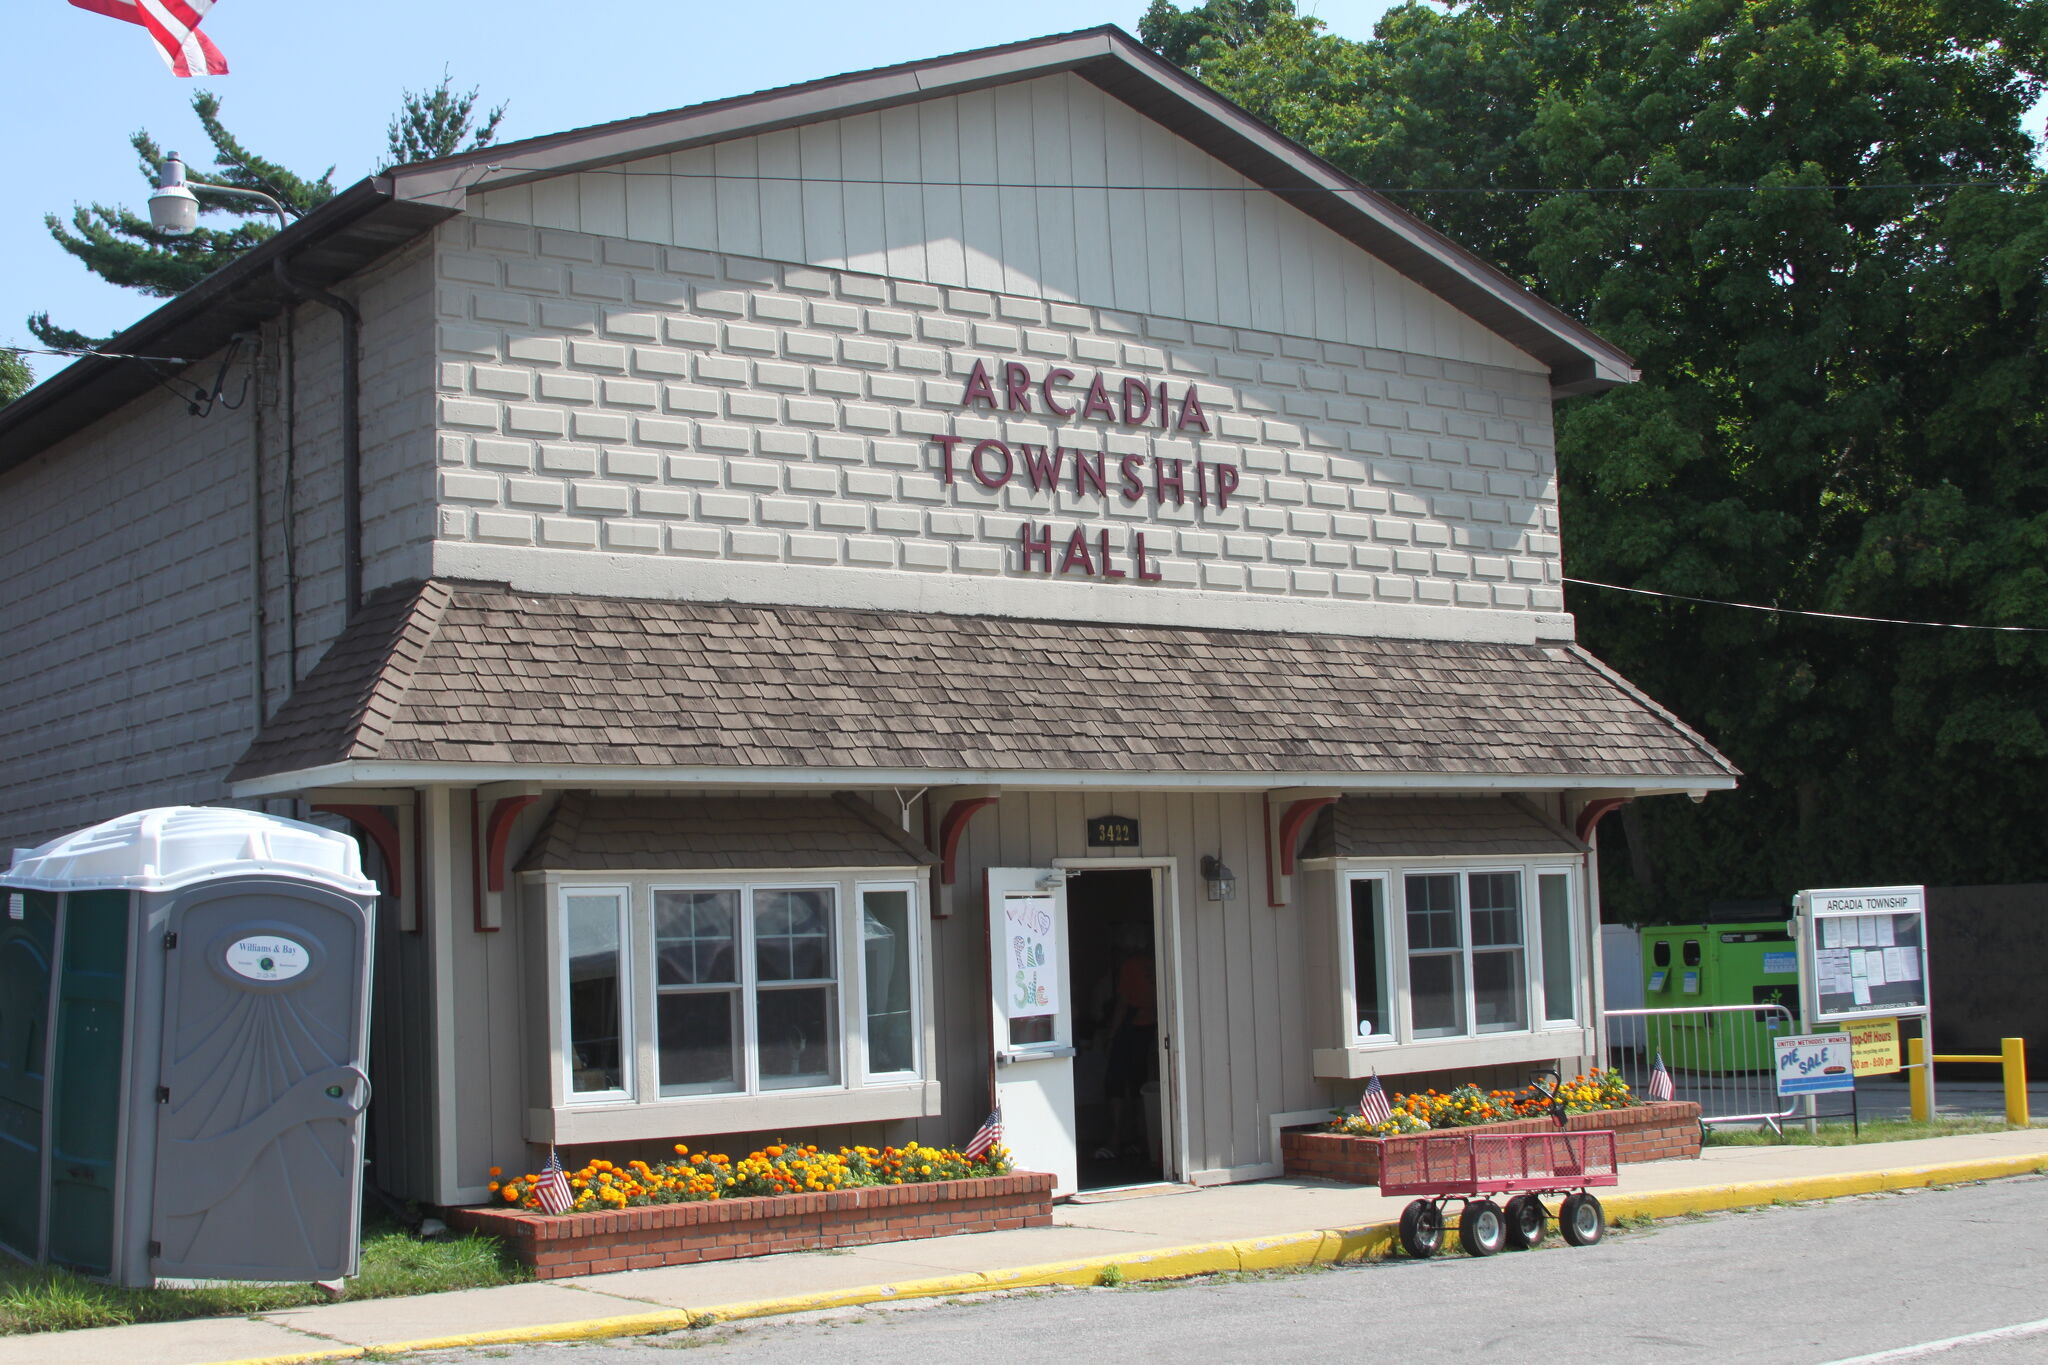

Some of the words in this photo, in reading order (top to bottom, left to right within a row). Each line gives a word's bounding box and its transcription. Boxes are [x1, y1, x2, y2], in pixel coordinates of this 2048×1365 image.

[963, 358, 1210, 433] ARCADIA
[932, 434, 1239, 509] TOWNSHIP
[1022, 522, 1162, 581] HALL
[1098, 824, 1129, 841] 3422
[1827, 899, 1863, 910] ARCADIA
[1866, 897, 1908, 909] TOWNSHIP
[239, 942, 272, 953] Williams
[273, 944, 280, 953] &
[282, 944, 296, 956] Bay
[1797, 1038, 1826, 1046] METHODIST
[1852, 1031, 1872, 1046] rop-Off
[1873, 1031, 1891, 1043] Hours
[1780, 1048, 1800, 1070] PIE
[1798, 1047, 1829, 1075] SALE
